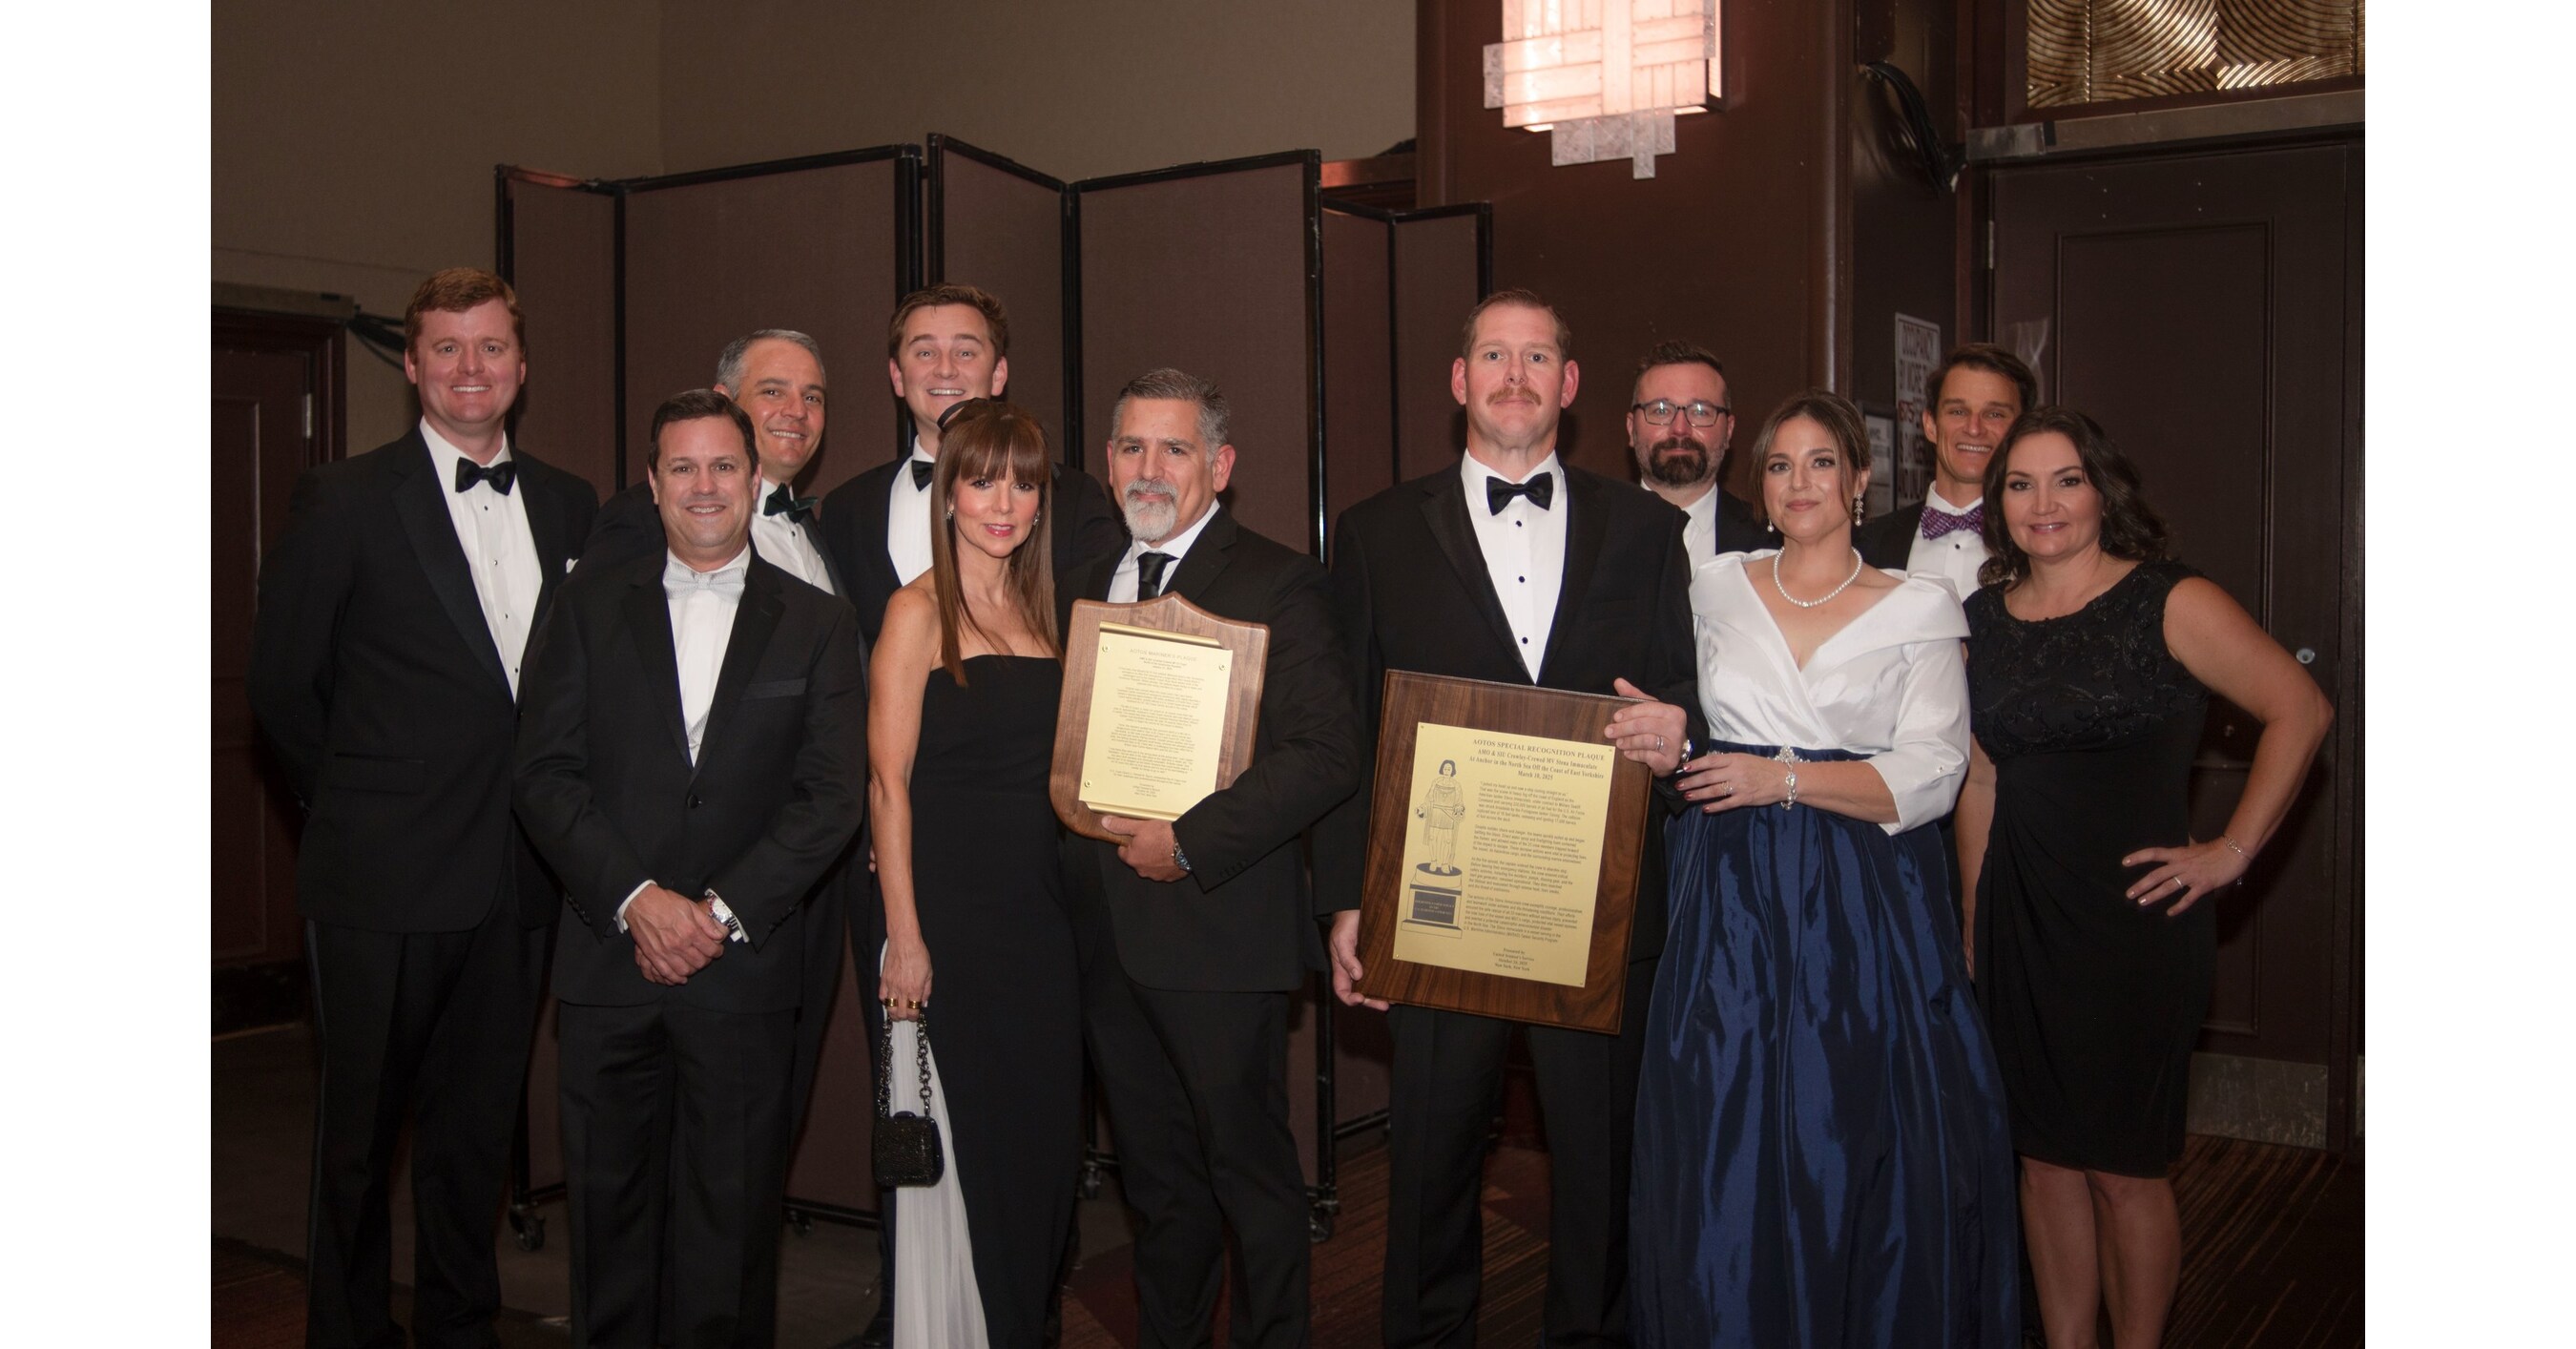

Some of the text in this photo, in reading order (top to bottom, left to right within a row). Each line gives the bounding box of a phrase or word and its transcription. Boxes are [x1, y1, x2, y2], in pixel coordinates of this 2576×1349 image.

[1473, 738, 1605, 760] AOTOS SPECIAL RECOGNITION PLAQUE
[1507, 753, 1546, 763] Crowley-Crewed
[1570, 760, 1598, 770] Immaculate
[1582, 771, 1604, 779] Yorkshire
